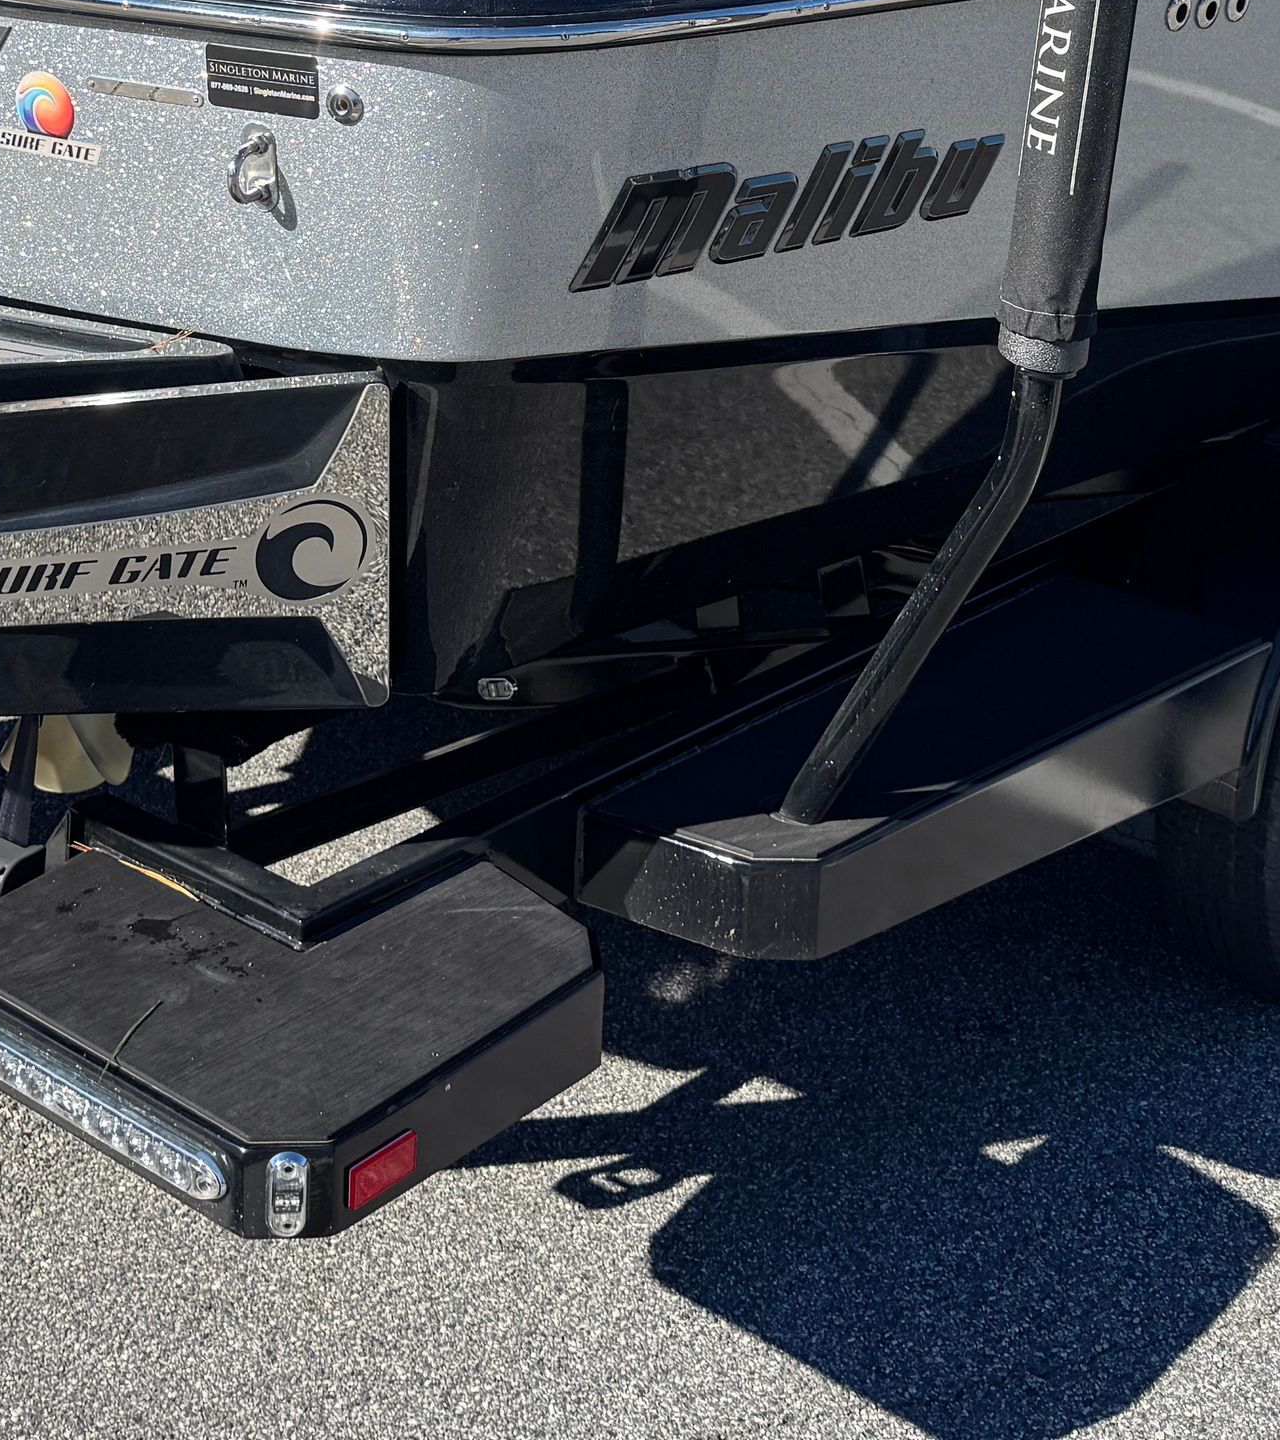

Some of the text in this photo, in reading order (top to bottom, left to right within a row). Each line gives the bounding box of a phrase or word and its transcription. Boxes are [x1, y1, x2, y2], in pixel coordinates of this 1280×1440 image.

[209, 62, 315, 85] SINGLETON MARINE
[0, 131, 97, 162] SURF GATE
[569, 128, 1006, 293] Malibu
[108, 546, 237, 585] GATE
